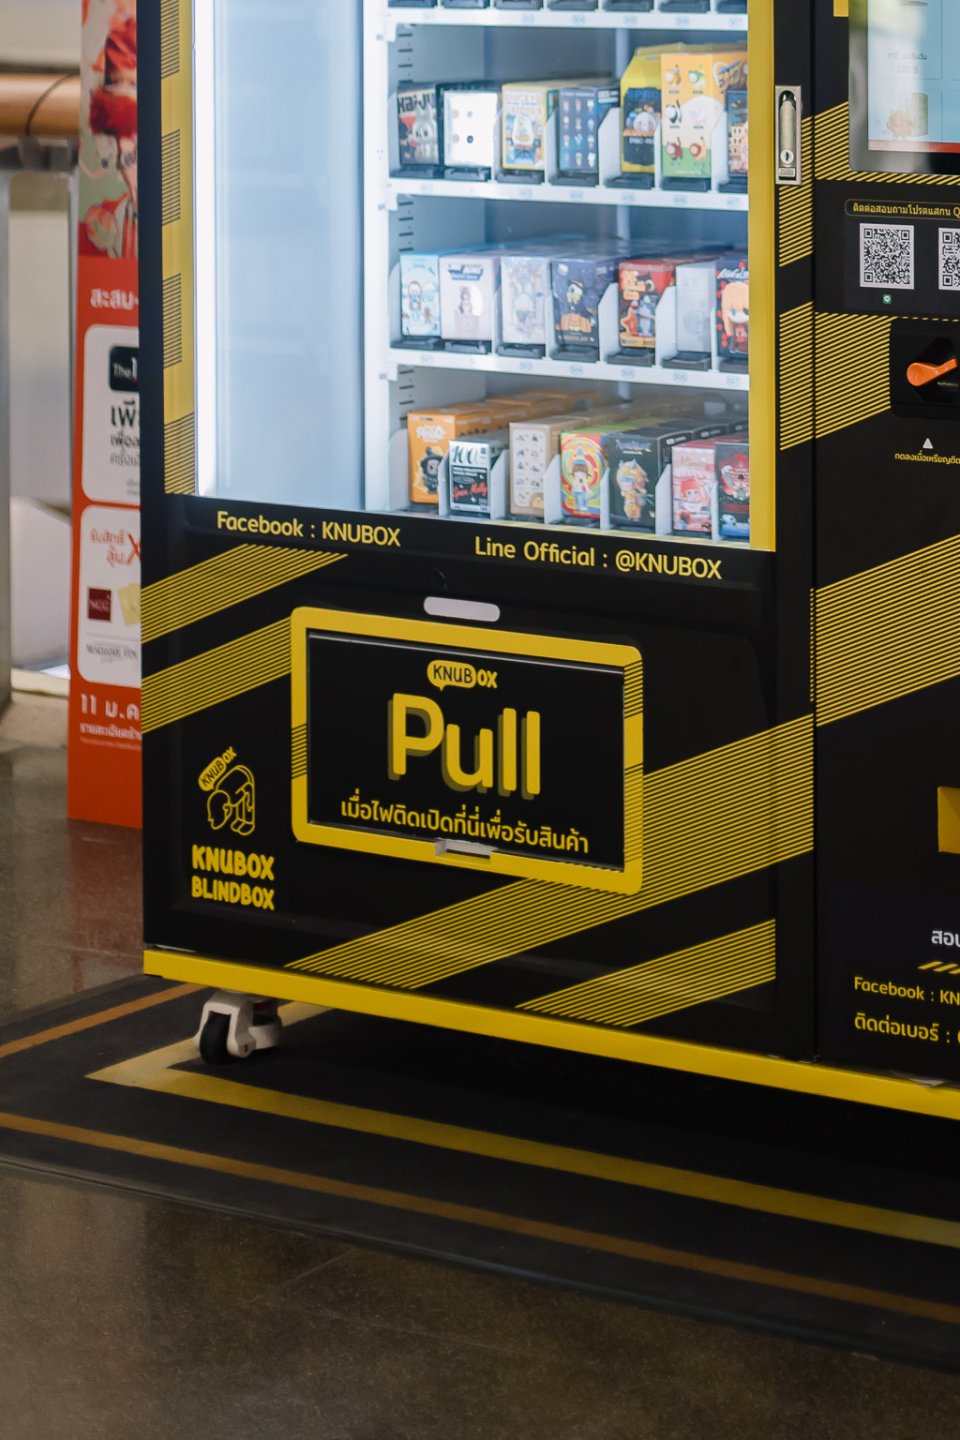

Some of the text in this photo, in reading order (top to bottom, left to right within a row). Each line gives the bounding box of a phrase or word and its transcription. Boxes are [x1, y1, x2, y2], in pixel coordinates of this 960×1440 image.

[217, 510, 303, 538] Facebook
[321, 520, 401, 548] KNUBOX
[475, 536, 516, 559] Line
[523, 541, 596, 567] Official
[614, 550, 722, 580] @KNUBOX
[432, 662, 498, 689] KNUBOX
[391, 692, 541, 797] Pull
[201, 745, 237, 787] KNUBOX
[340, 788, 589, 854] เมื่อไฟติดเปิดที่นี่เพื่อรับสินค้า
[192, 844, 275, 881] KNUBOX
[191, 875, 275, 910] BLINDBOX
[854, 976, 925, 1002] Facebook
[854, 1012, 940, 1043] ติดต่อเบอร์
